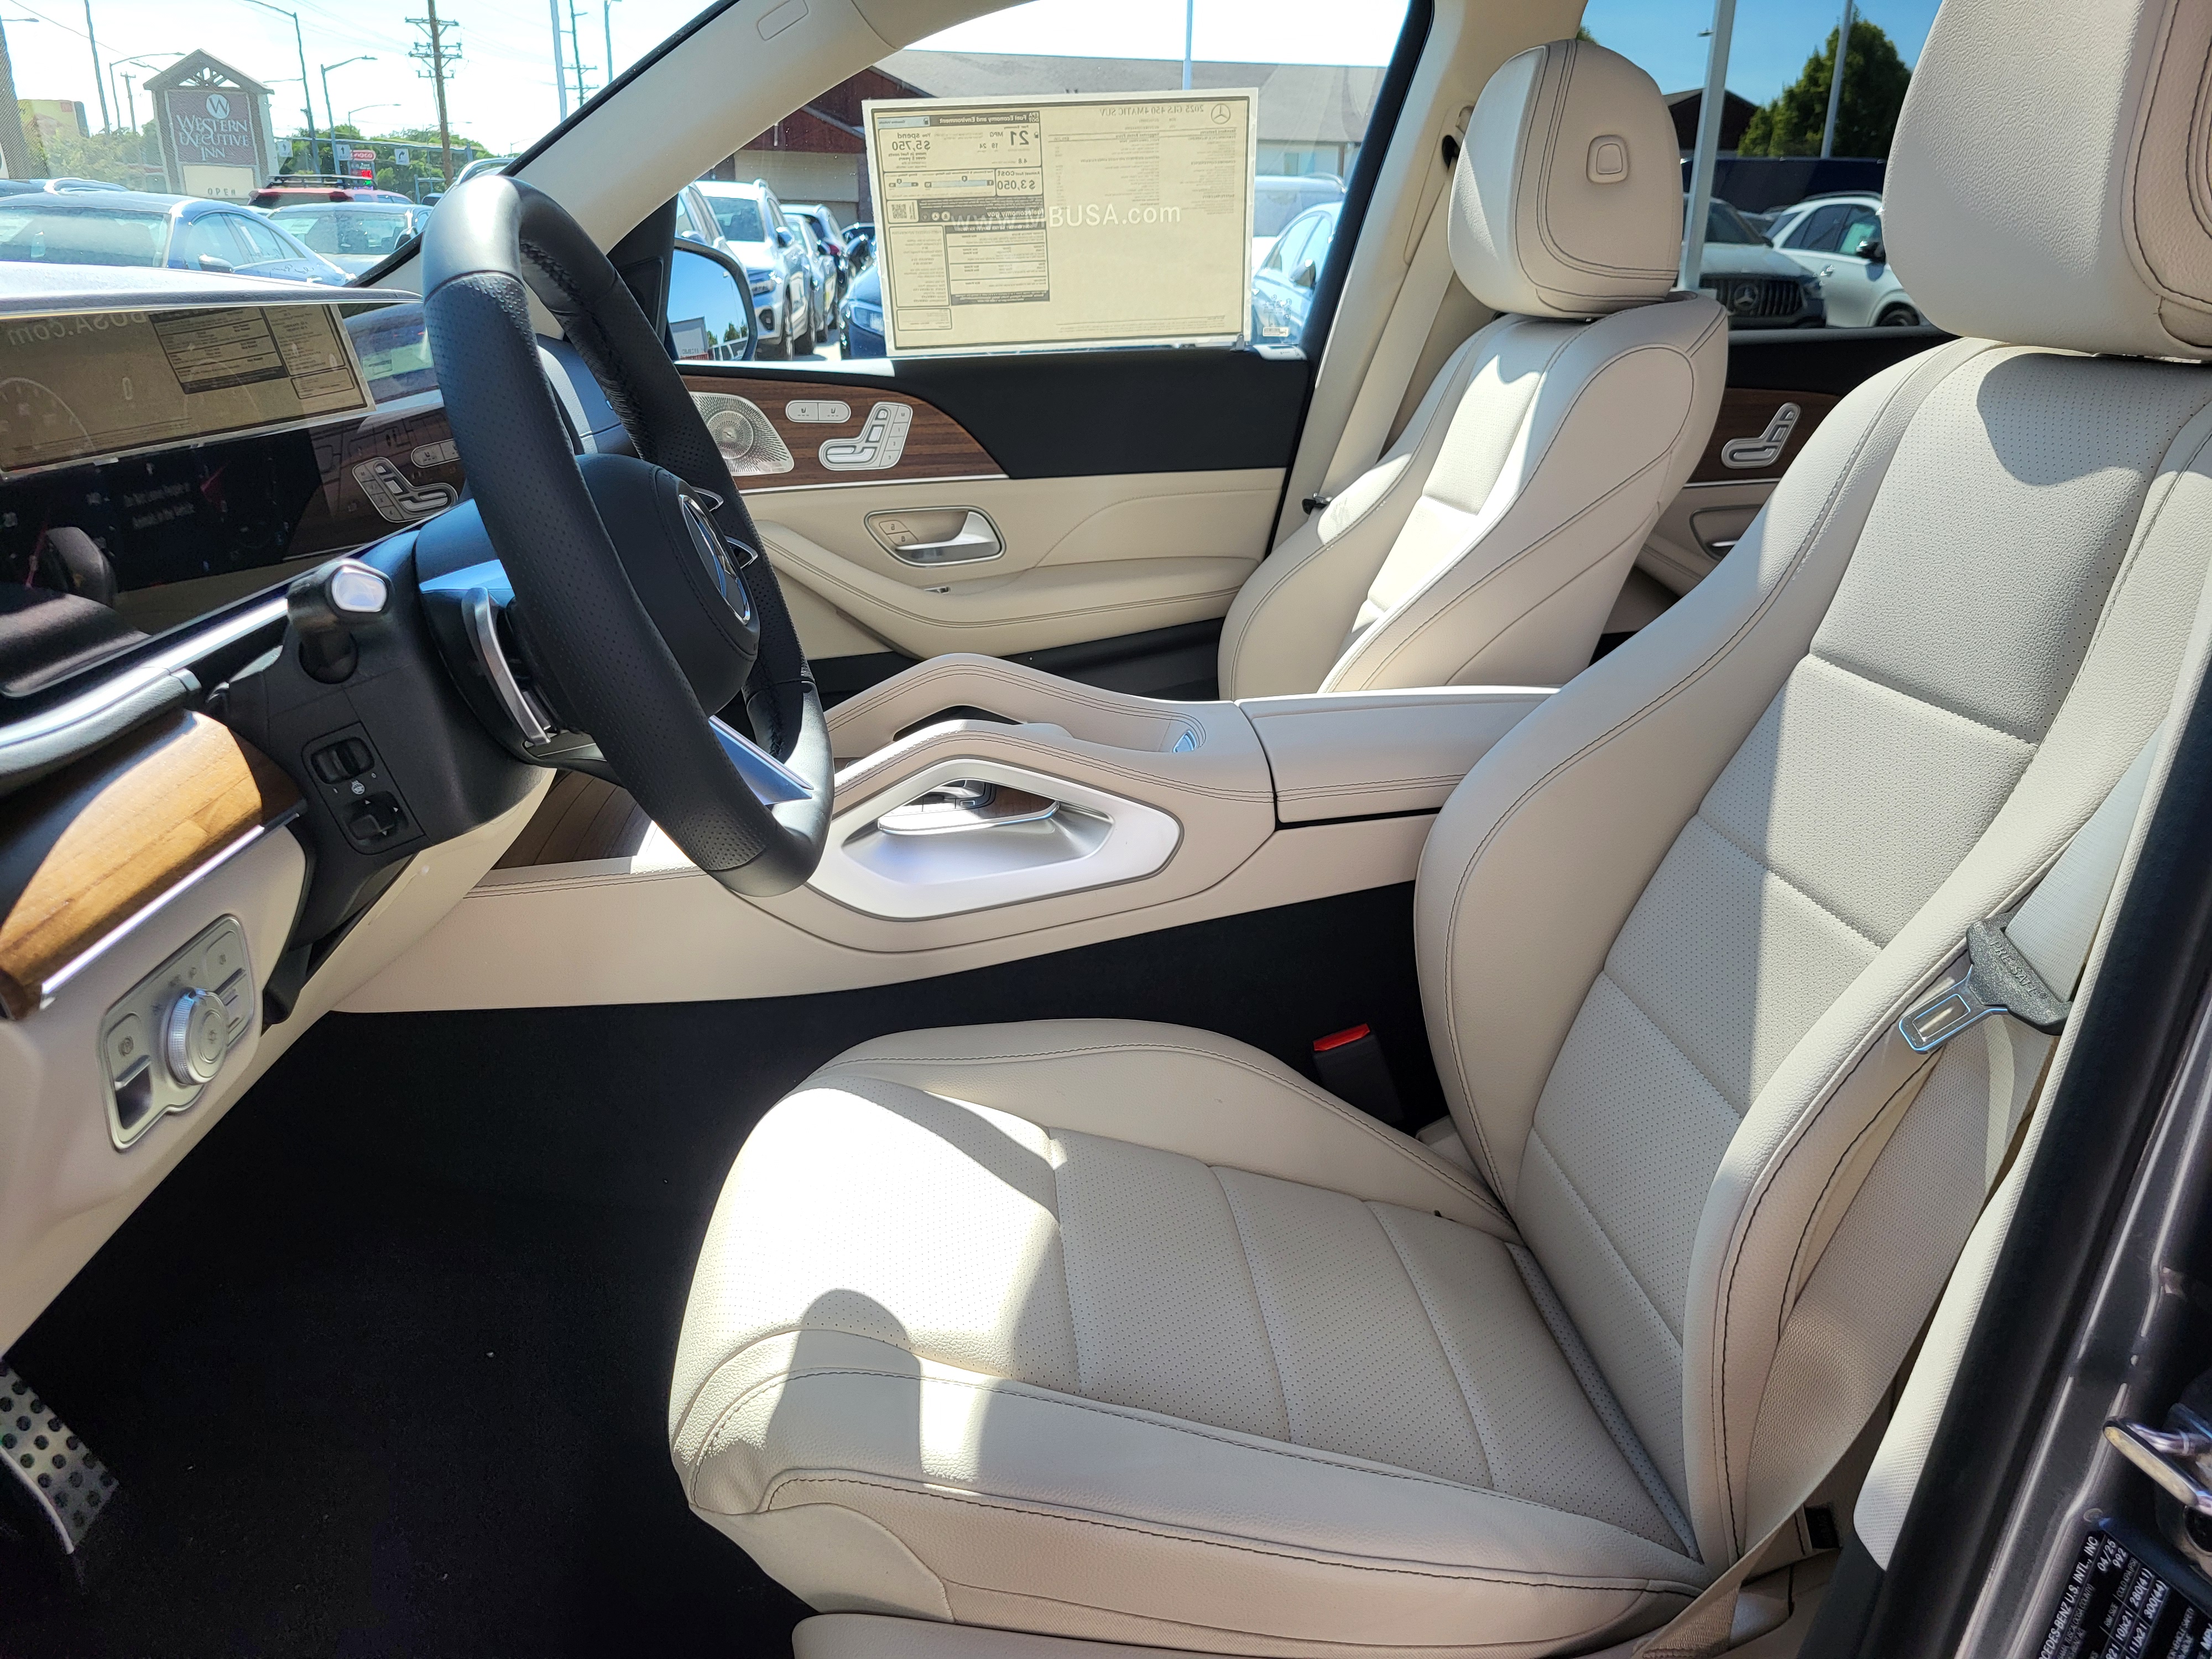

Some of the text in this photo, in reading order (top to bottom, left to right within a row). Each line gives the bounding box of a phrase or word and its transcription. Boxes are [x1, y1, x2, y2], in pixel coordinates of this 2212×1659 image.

[176, 114, 248, 133] WESTERN
[179, 133, 249, 148] EXECUTIVE
[201, 147, 226, 161] INN
[207, 187, 236, 196] OPEN
[2097, 1538, 2117, 1572] 04/25
[2112, 1547, 2127, 1568] 992
[2064, 1584, 2080, 1604] U.S.
[2083, 1536, 2099, 1557] INC
[2129, 1568, 2153, 1608] 280(41)
[2143, 1580, 2168, 1620] 300(44)
[2200, 1623, 2212, 1651] MP
